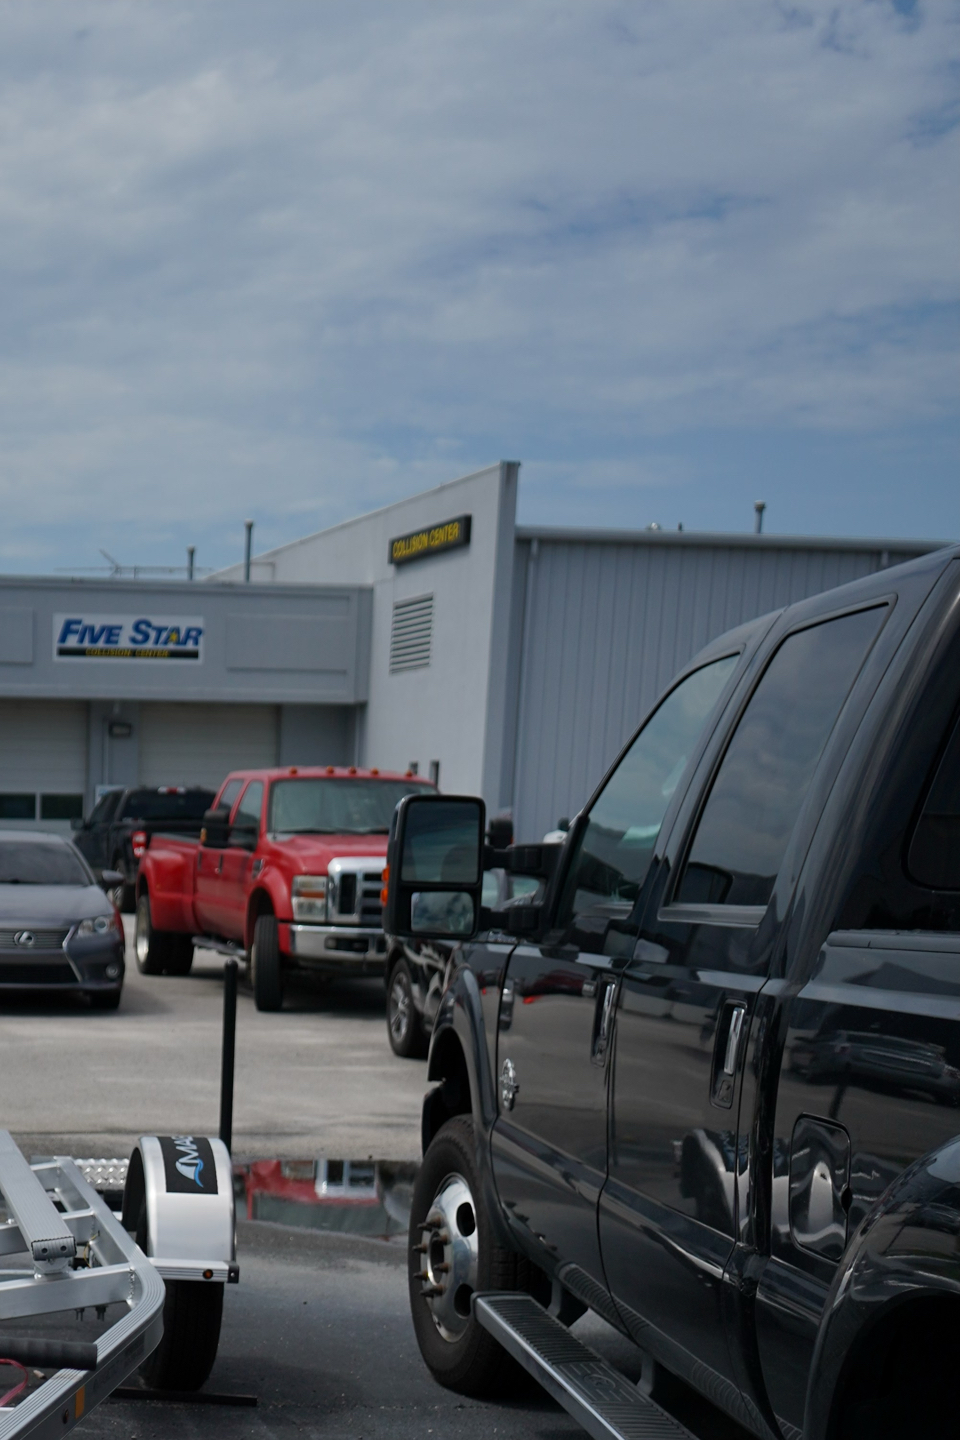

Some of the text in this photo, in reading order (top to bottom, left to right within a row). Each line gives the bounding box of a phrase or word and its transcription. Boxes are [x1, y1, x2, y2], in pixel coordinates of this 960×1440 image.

[392, 521, 460, 559] COLLISION CENTER
[57, 618, 205, 647] FIVE STAR
[85, 648, 170, 658] COLLISION CENTER
